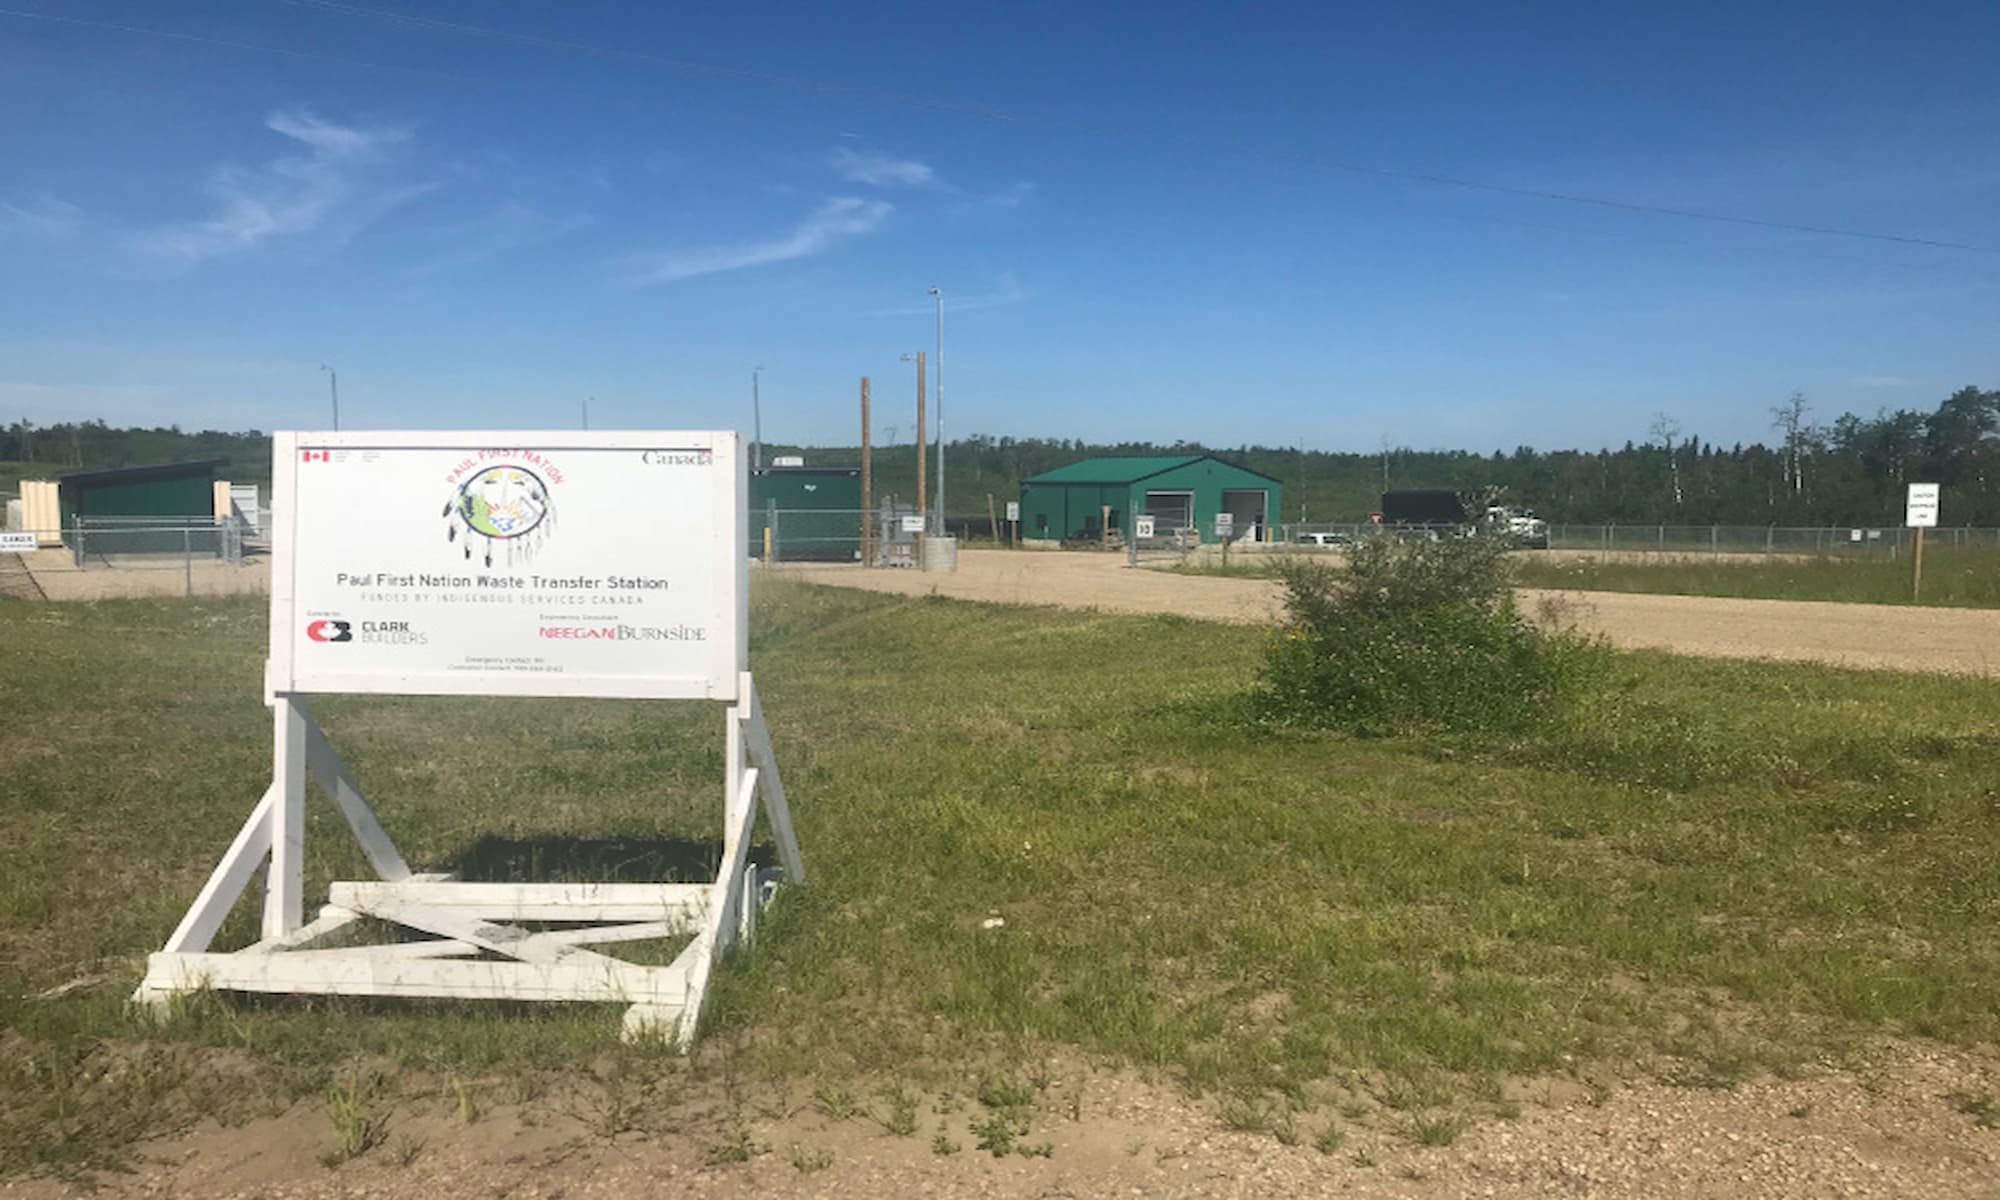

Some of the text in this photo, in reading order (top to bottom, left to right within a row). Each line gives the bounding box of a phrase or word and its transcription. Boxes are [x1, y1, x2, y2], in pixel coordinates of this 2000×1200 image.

[642, 449, 712, 466] Canada
[447, 448, 564, 484] PAUL FIRST NATION
[337, 573, 669, 590] Paul First Nation Waste Transfer Station
[361, 593, 644, 604] FUNDED BY INDIGENOUS SERVICES CANADA
[362, 621, 409, 632] CLARK
[362, 632, 429, 645] BUILDERS
[539, 627, 615, 640] NEEGAN
